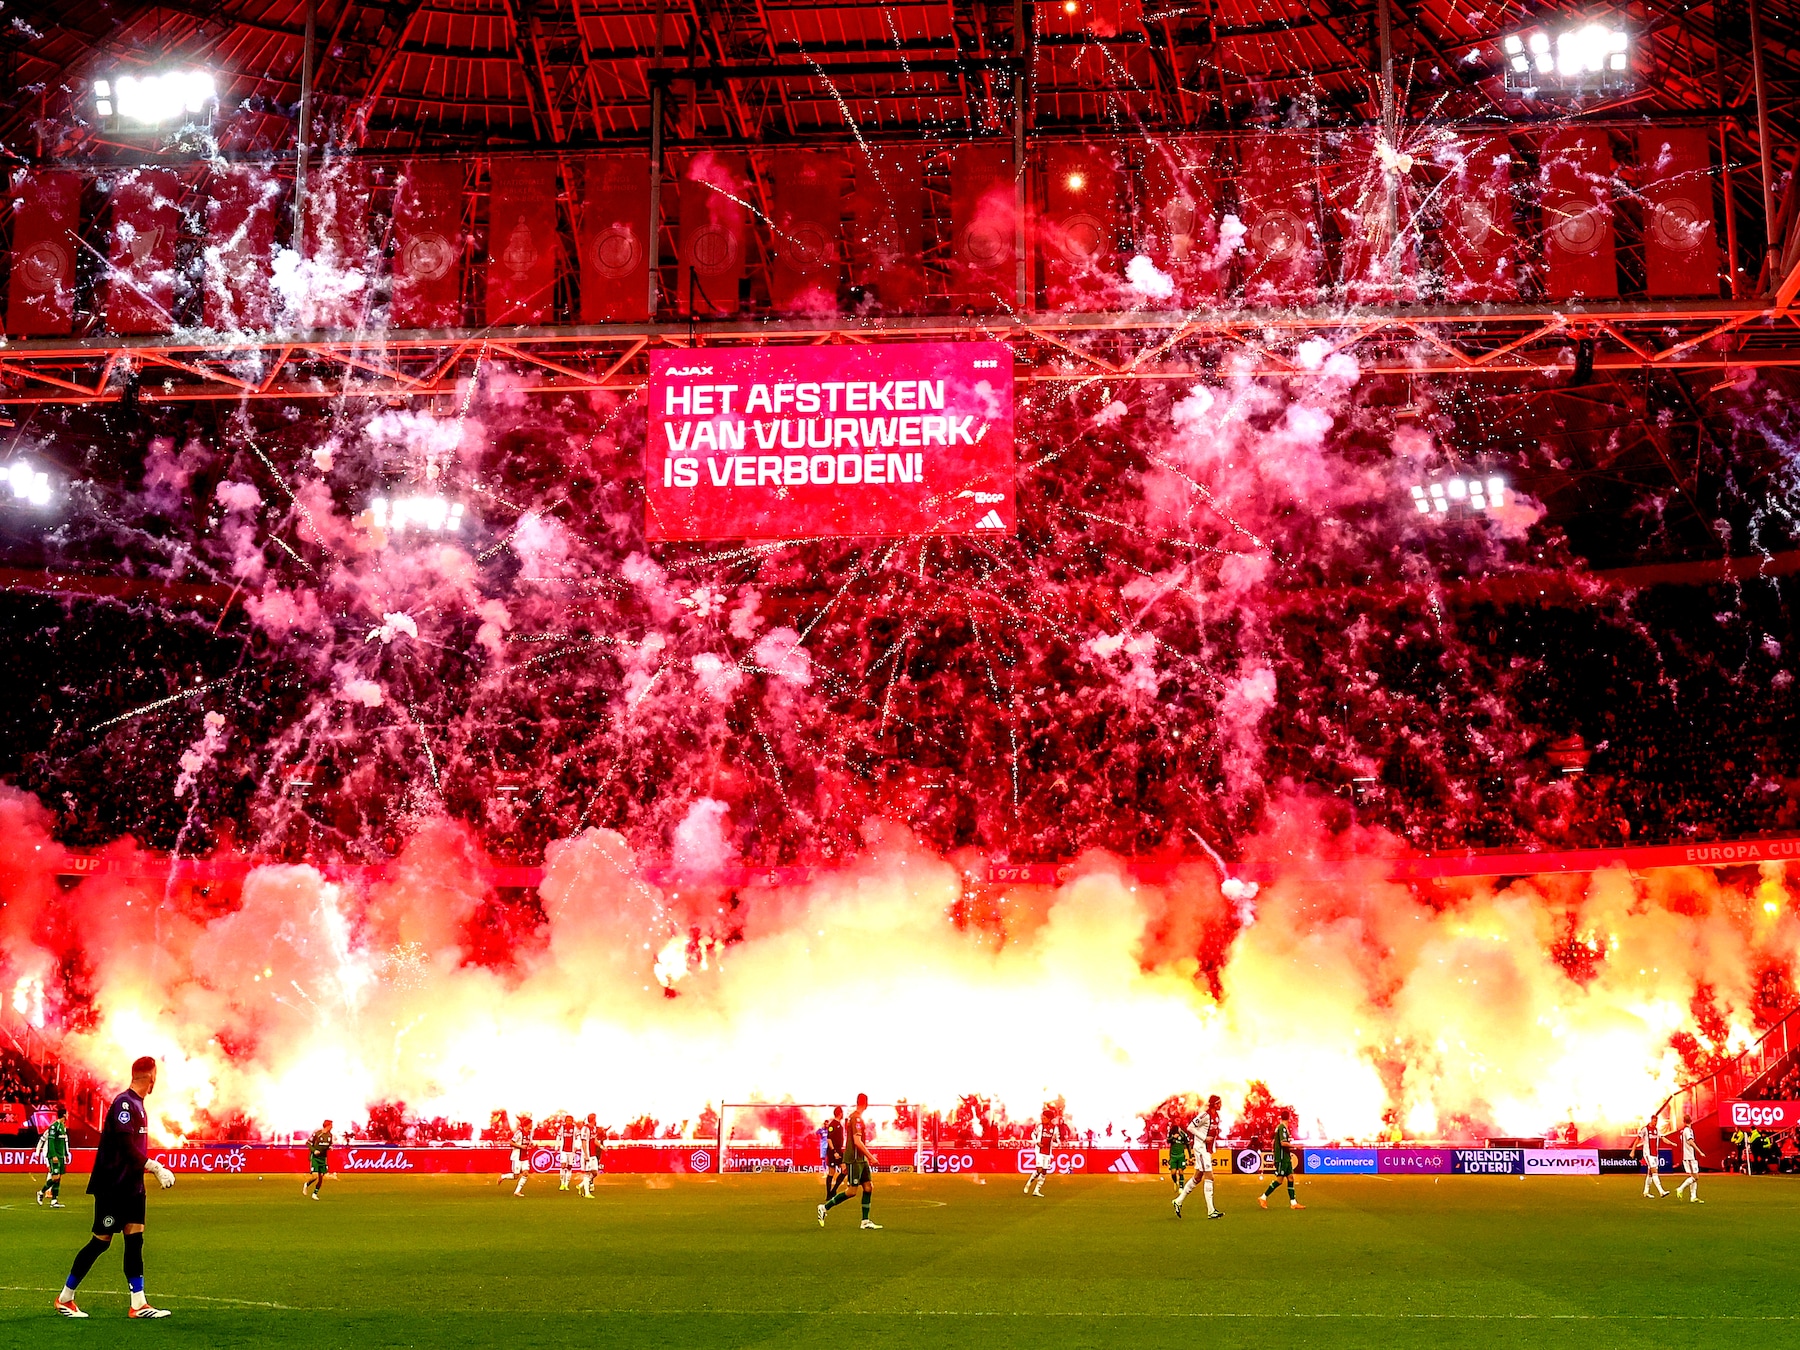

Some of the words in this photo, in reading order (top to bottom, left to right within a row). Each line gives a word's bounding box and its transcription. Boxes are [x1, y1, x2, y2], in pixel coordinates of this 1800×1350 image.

[665, 366, 714, 376] AJAX
[666, 385, 738, 415] HET
[745, 380, 944, 413] AFSTEKEN
[664, 420, 745, 450] VAN
[754, 415, 974, 449] VUURWERK
[664, 457, 699, 487] IS
[707, 453, 924, 486] VERBODEN!
[1686, 845, 1761, 861] EUROPA
[63, 858, 100, 870] CUP
[989, 868, 1030, 880] 1976
[1732, 1102, 1784, 1125] Ziggo
[344, 1149, 414, 1169] Sandals
[1324, 1156, 1374, 1166] Coinmerce
[1384, 1157, 1442, 1168] CURAÇAO
[1455, 1151, 1520, 1162] VRIENDEN
[1527, 1158, 1596, 1167] OLYMPIA
[1600, 1158, 1638, 1166] Heineken
[1464, 1162, 1512, 1174] LOTERIJ
